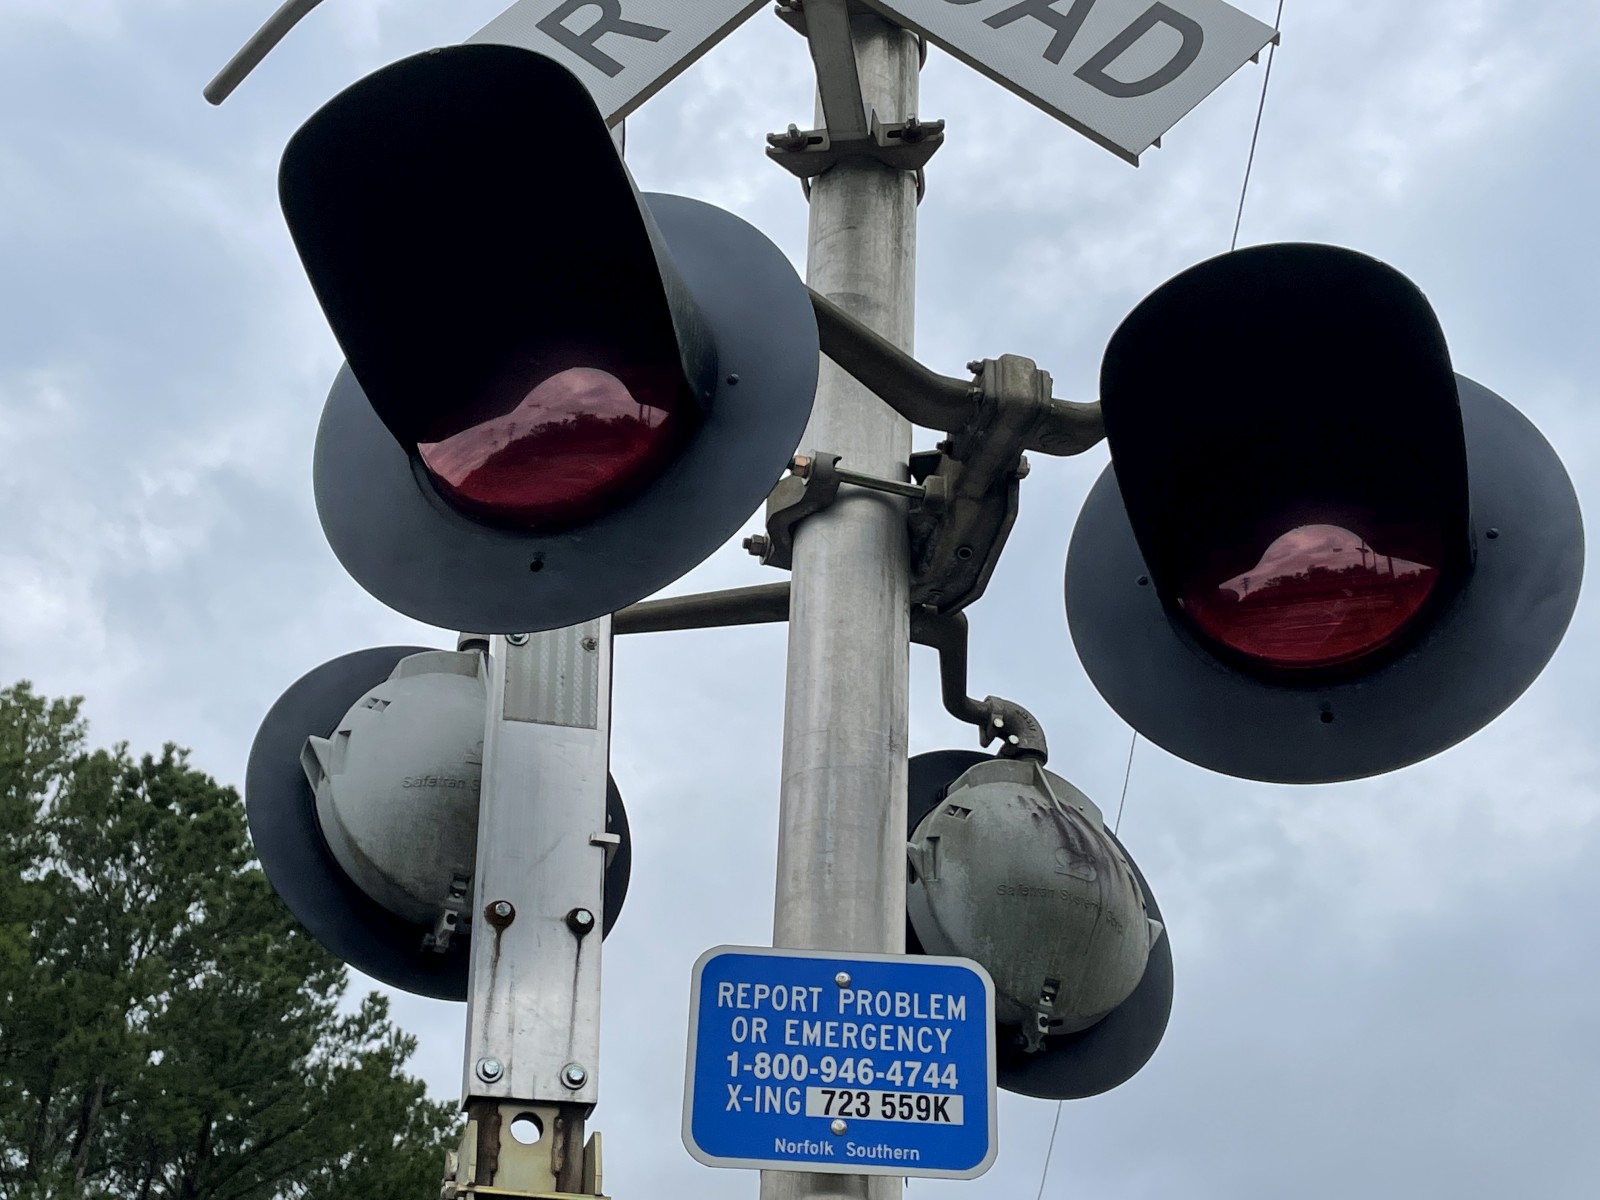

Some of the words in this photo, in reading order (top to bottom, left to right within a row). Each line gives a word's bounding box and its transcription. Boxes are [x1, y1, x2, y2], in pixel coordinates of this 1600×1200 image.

[717, 981, 823, 1013] REPORT
[839, 988, 967, 1021] PROBLEM
[731, 1016, 768, 1044] OR
[784, 1019, 952, 1054] EMERGENCY
[726, 1051, 959, 1089] 1-800-946-4744
[725, 1084, 801, 1114] X-ING
[820, 1089, 871, 1118] 723
[881, 1093, 951, 1122] 559K
[774, 1138, 834, 1156] Norfolk
[846, 1141, 920, 1161] Southern
